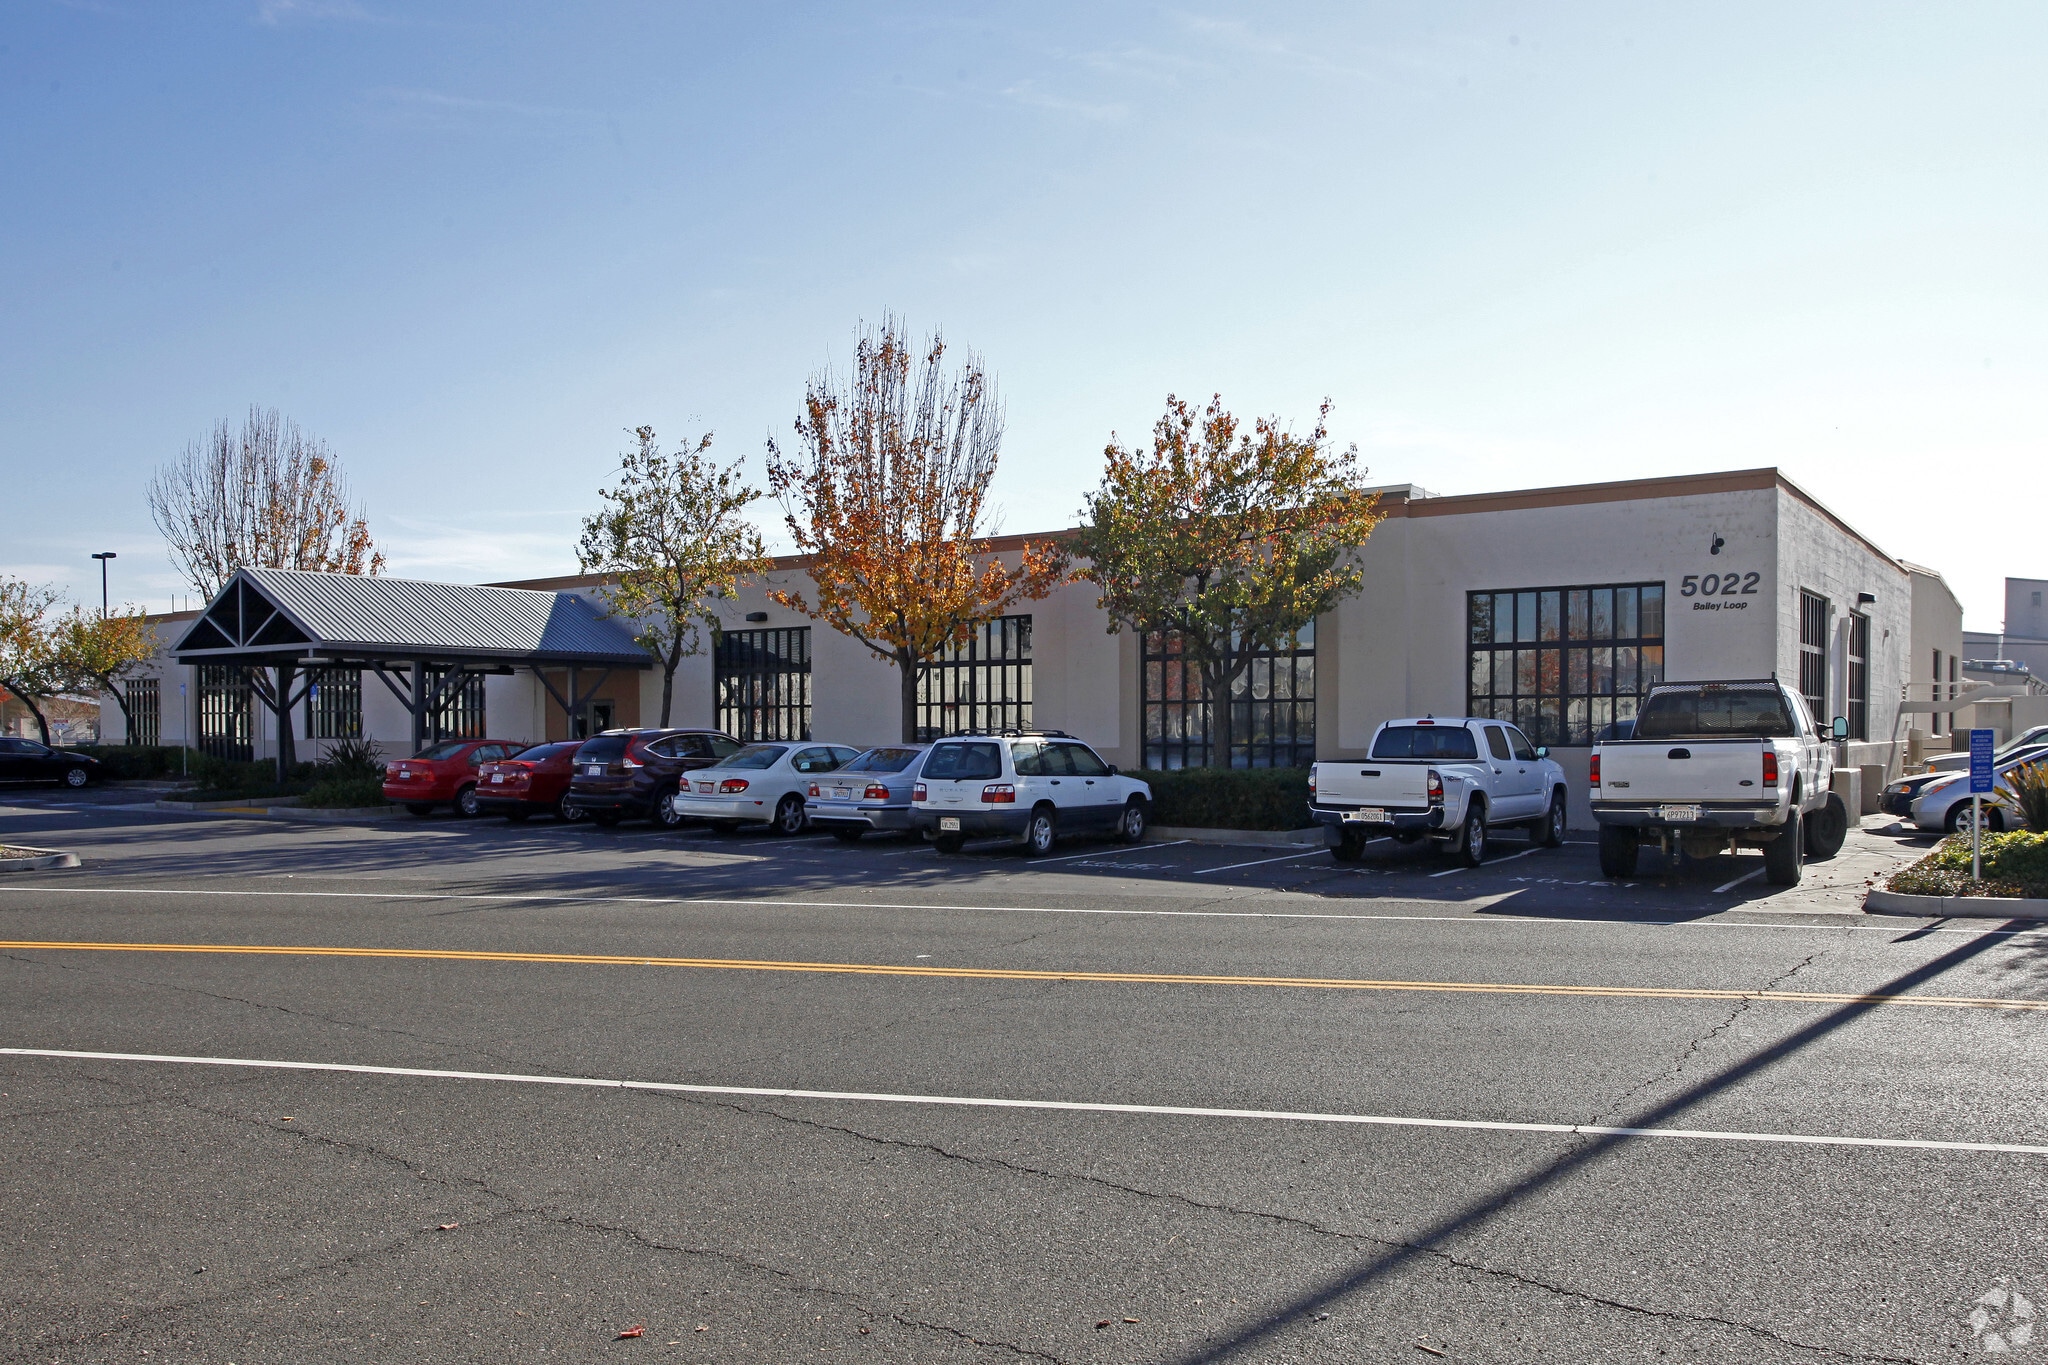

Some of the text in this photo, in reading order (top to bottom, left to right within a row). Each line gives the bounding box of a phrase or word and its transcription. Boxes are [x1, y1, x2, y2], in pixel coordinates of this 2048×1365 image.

[1681, 572, 1760, 597] 5022
[1693, 601, 1748, 611] Bailey Loop
[1666, 810, 1694, 819] 6P97213
